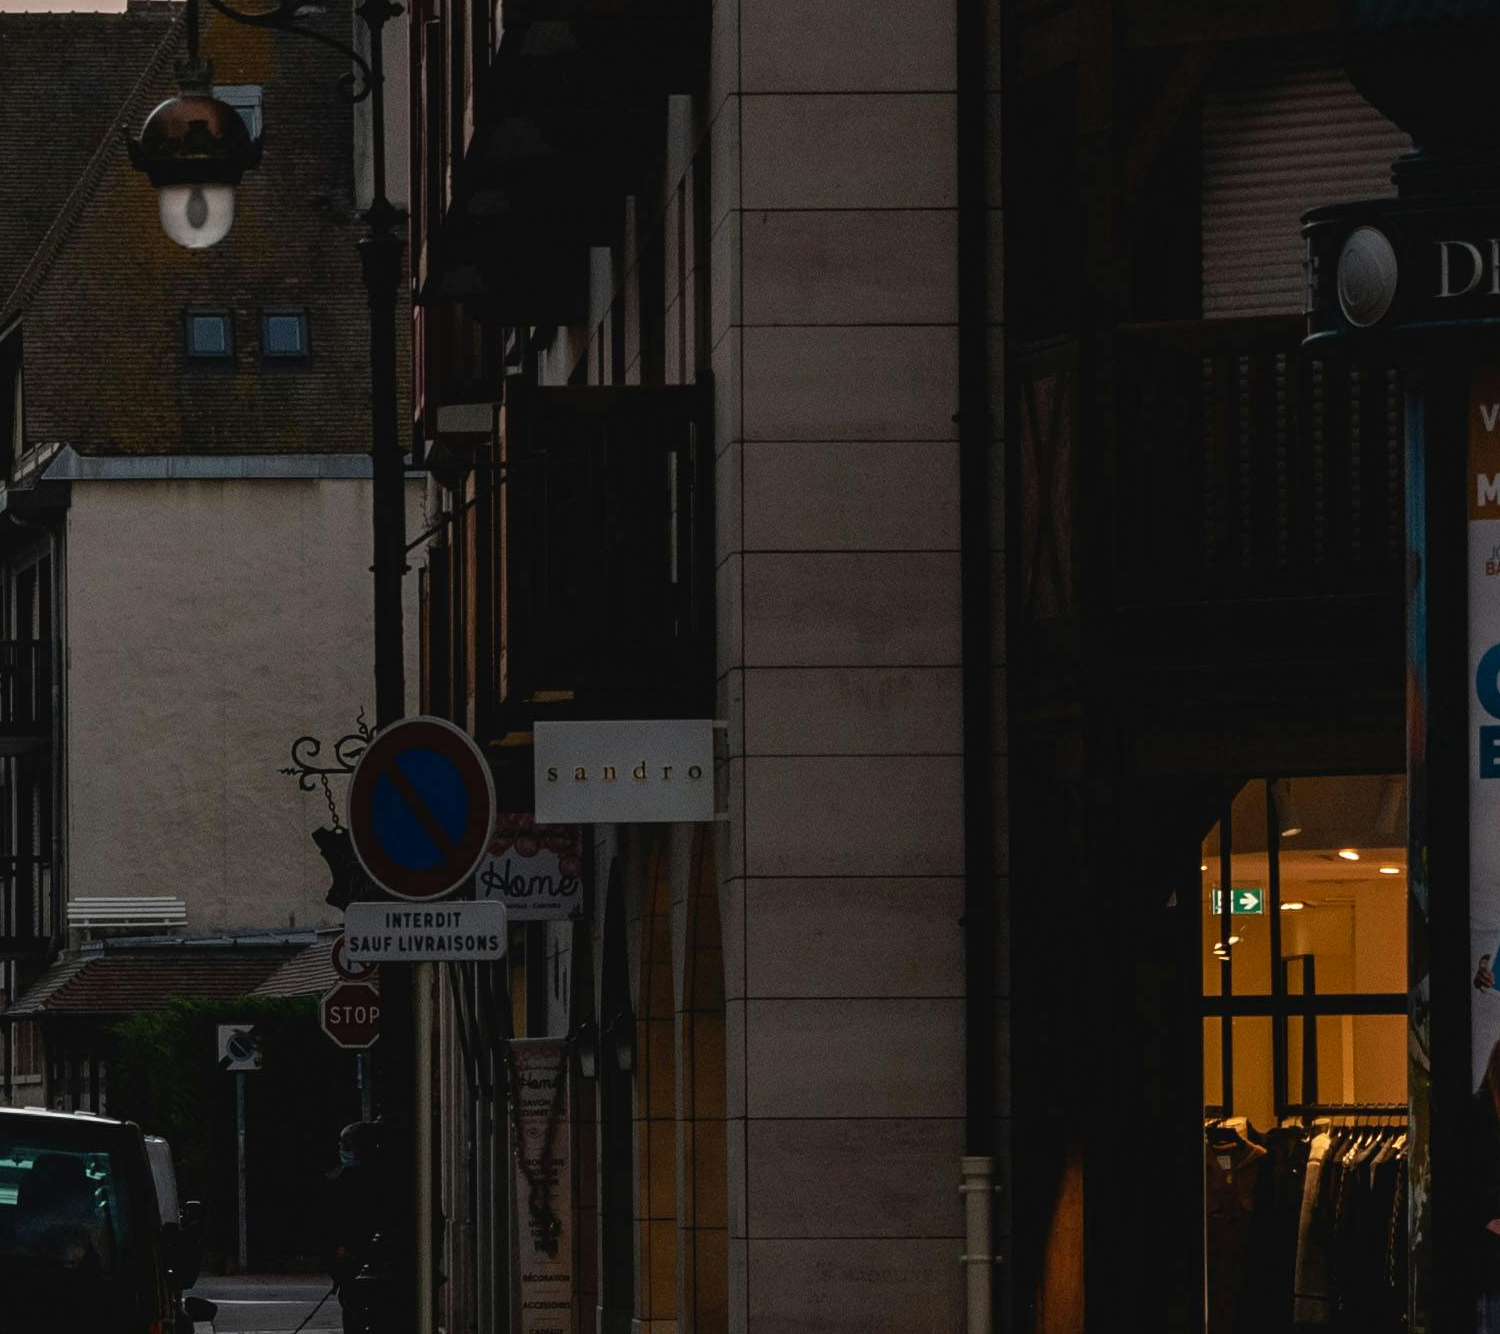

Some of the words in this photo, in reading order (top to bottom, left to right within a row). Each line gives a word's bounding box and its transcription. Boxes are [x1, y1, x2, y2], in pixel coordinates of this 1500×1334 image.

[547, 760, 703, 783] sandro
[480, 858, 580, 899] Home
[385, 912, 463, 929] INTERDIT
[350, 935, 392, 952] SAUF
[399, 935, 499, 952] LIVRAISONS
[328, 1006, 381, 1025] STOP
